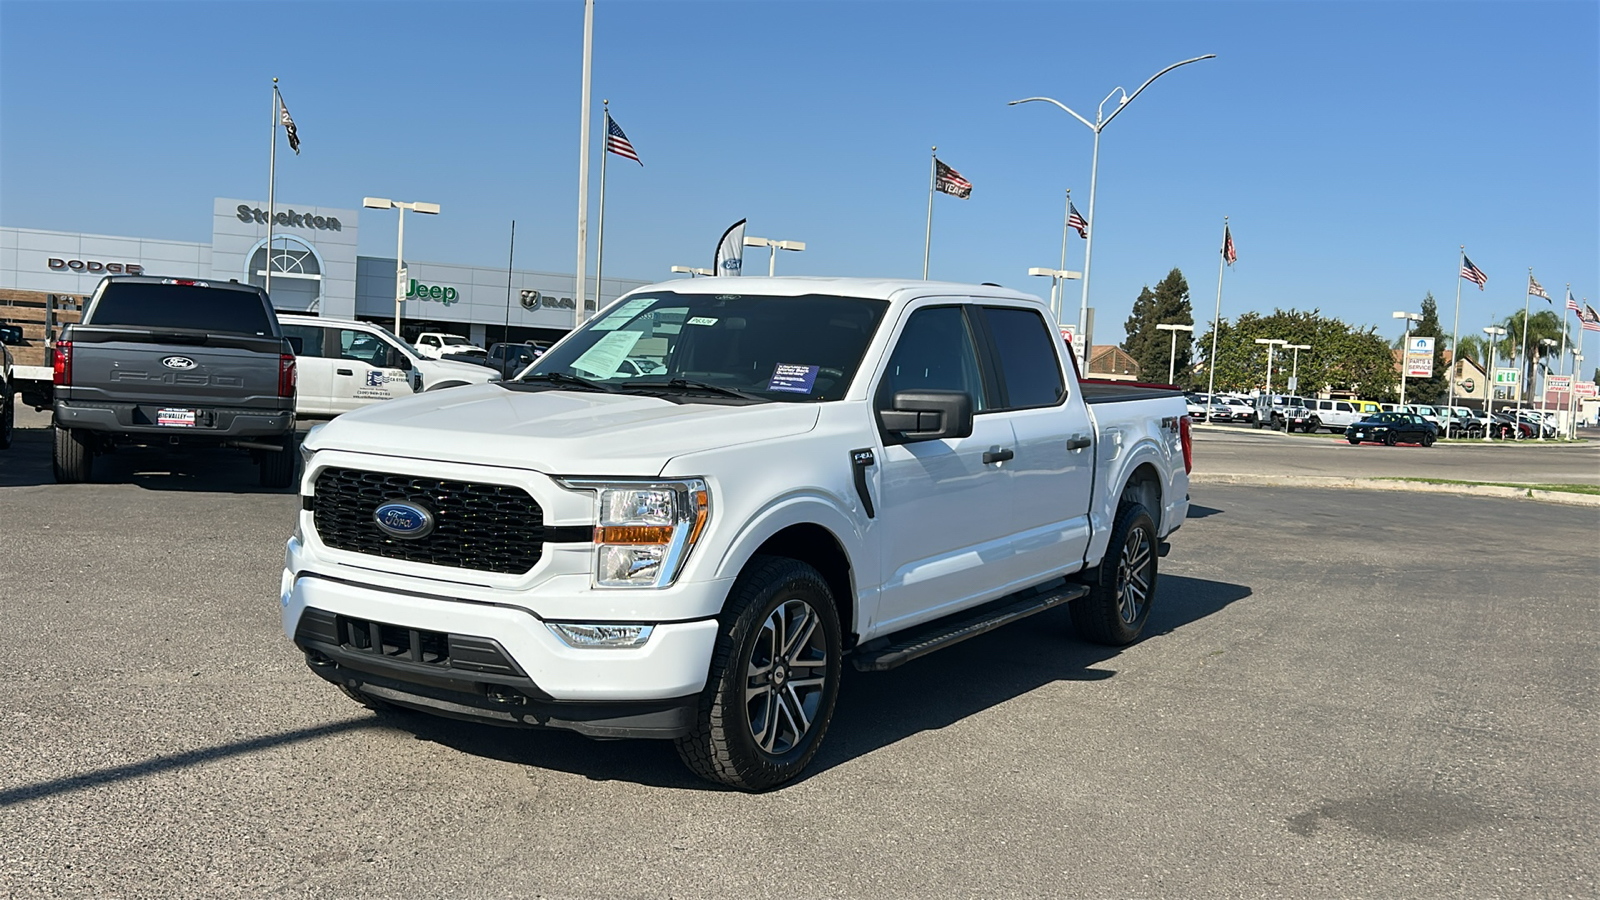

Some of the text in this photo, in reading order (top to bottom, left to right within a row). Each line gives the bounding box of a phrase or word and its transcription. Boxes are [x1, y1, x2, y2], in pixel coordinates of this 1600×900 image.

[237, 204, 341, 231] Stockton
[47, 257, 143, 274] DODGE
[406, 278, 456, 303] Jeep
[168, 357, 189, 368] Ford
[110, 370, 244, 389] F-150
[385, 509, 414, 529] Ford
